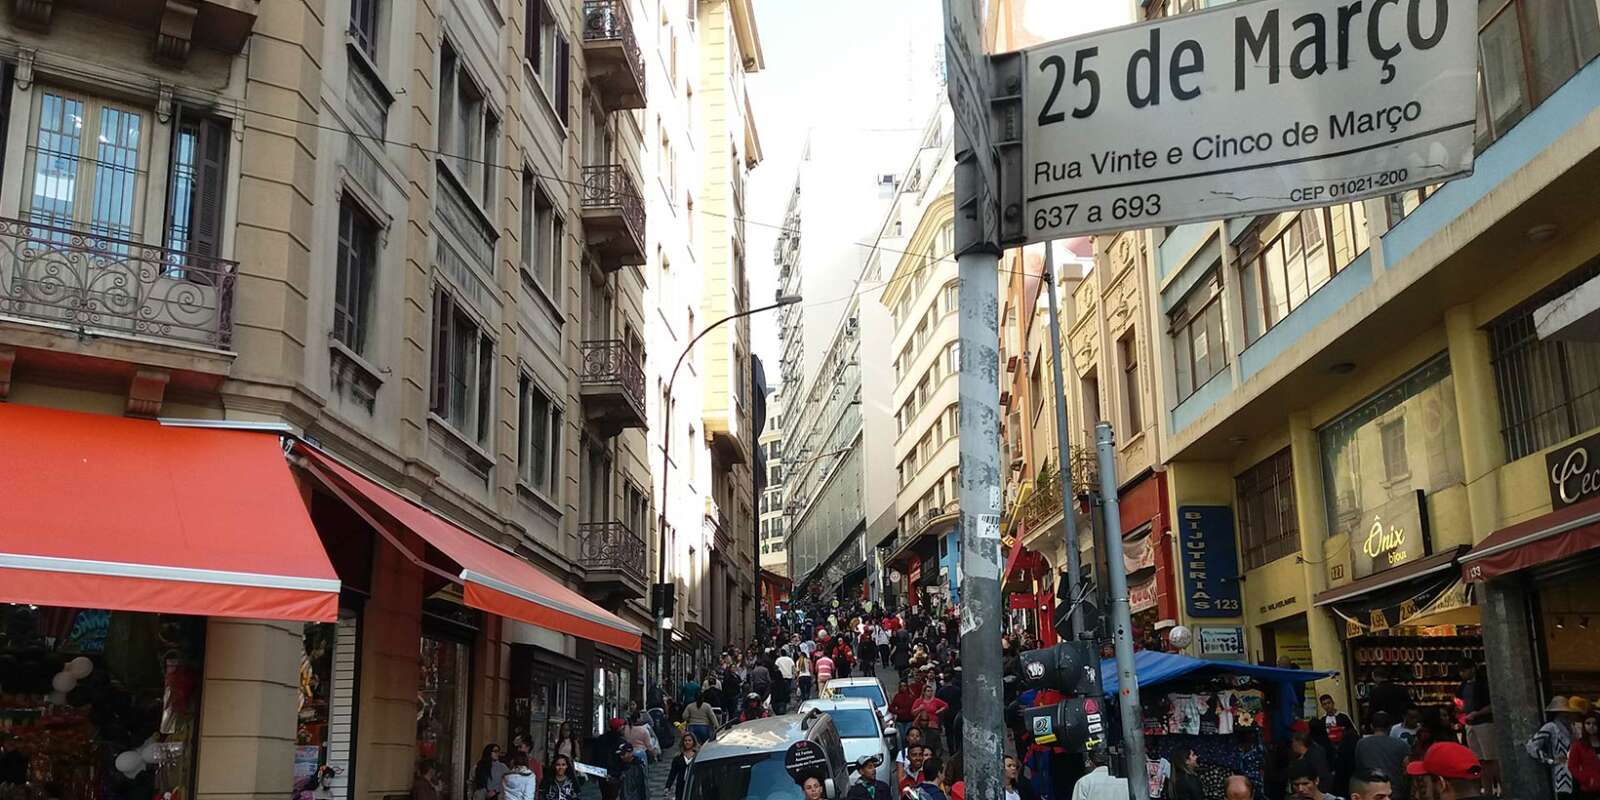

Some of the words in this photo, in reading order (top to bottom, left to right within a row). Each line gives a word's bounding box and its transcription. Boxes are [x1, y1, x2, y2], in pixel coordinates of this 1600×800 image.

[1038, 46, 1100, 126] 25
[1127, 28, 1204, 109] de
[1235, 0, 1448, 91] Março
[1034, 160, 1082, 184] Rua
[1091, 148, 1157, 175] Vinte
[1167, 146, 1183, 164] e
[1193, 133, 1272, 160] Cinco
[1282, 121, 1319, 147] de
[1329, 100, 1422, 140] Março
[1290, 186, 1325, 202] CEP
[1329, 168, 1408, 197] 01021-200
[1034, 204, 1078, 231] 637
[1087, 206, 1102, 223] a
[1112, 194, 1161, 220] 693
[1363, 514, 1405, 558] Ônix
[1184, 511, 1211, 610] BIJUTERIAS
[1214, 599, 1239, 610] 123
